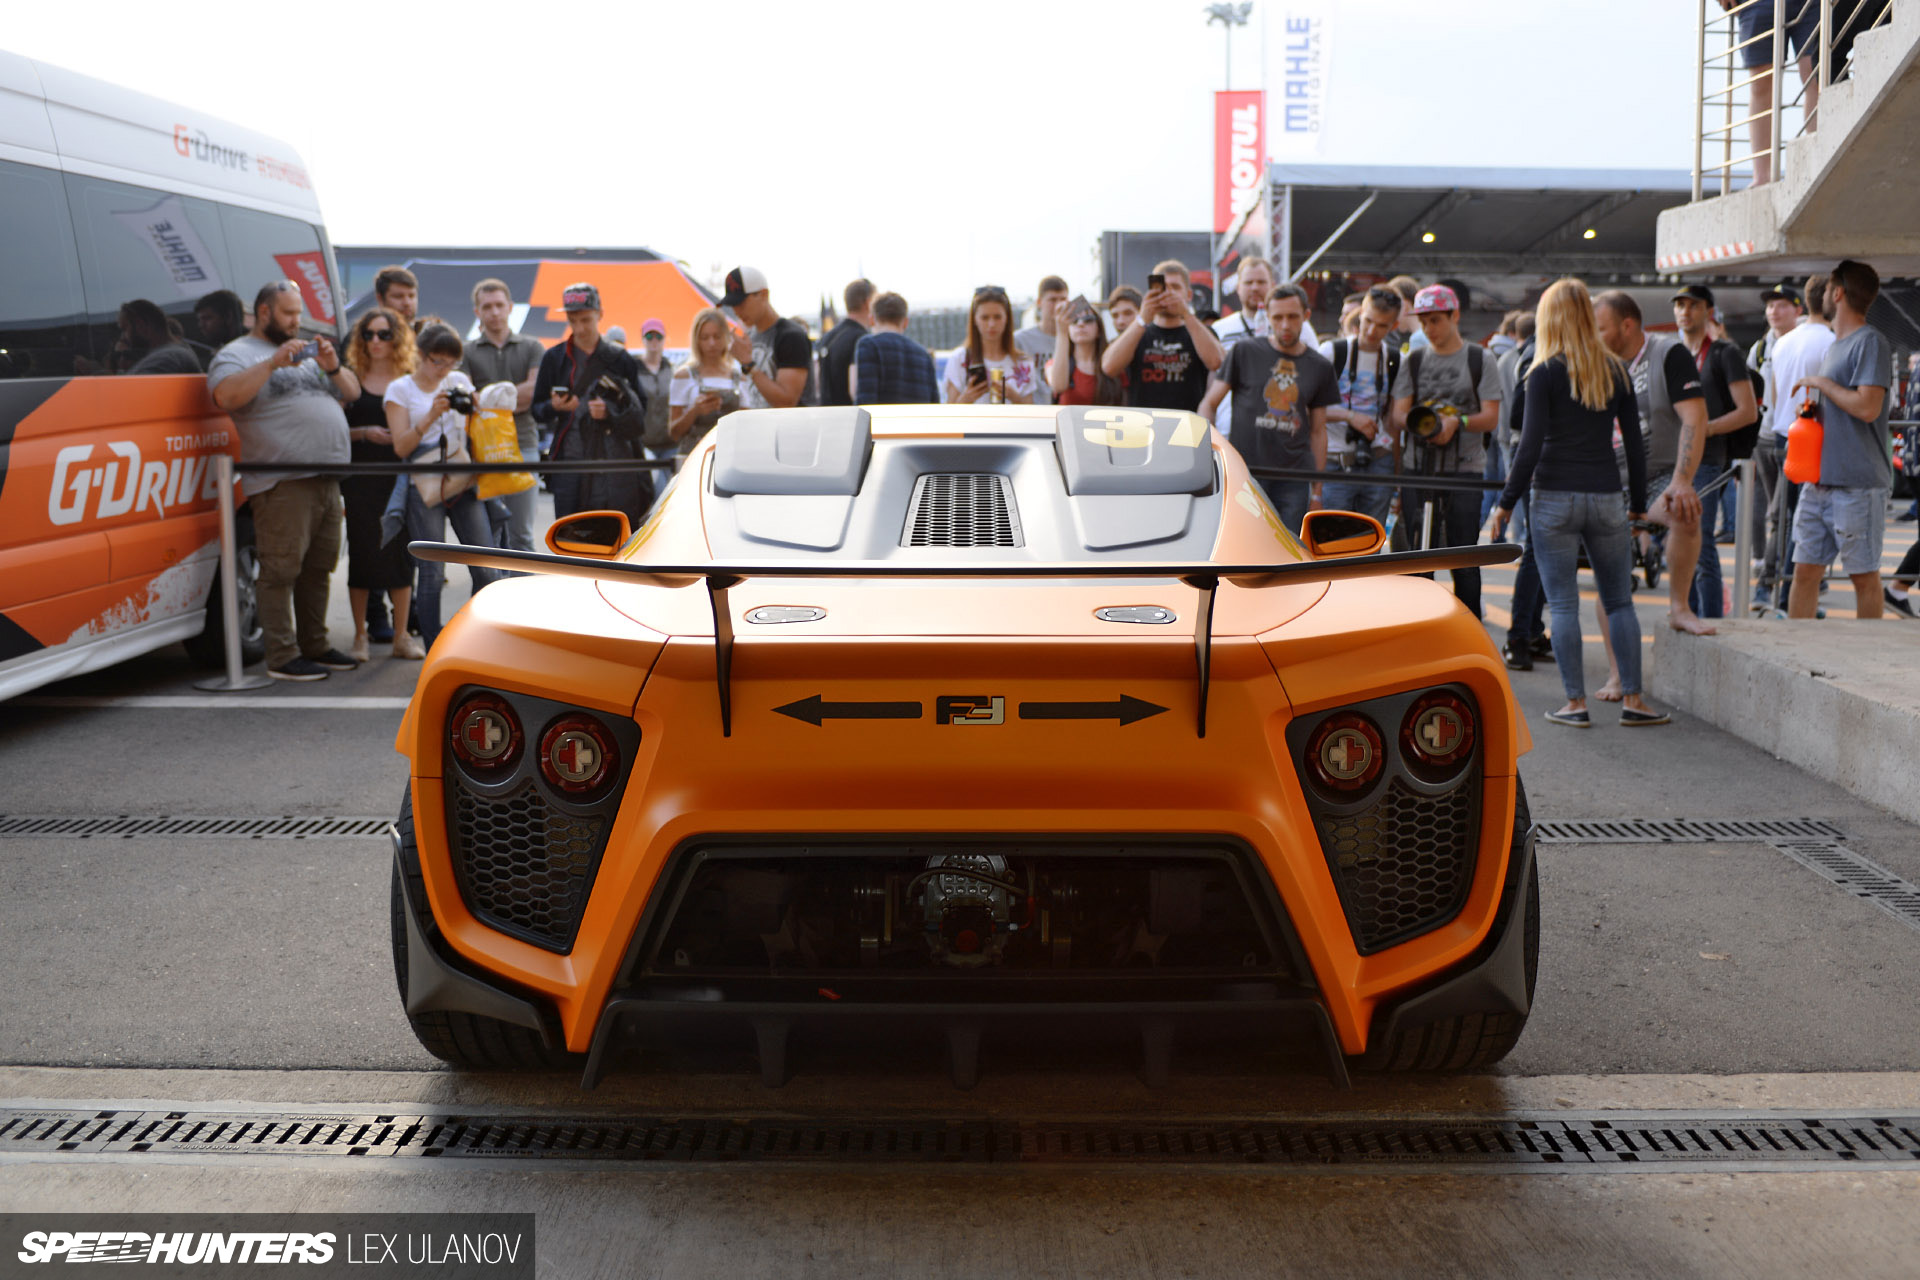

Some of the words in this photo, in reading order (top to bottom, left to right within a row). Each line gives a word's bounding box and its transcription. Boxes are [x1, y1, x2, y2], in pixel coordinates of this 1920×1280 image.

[1285, 18, 1309, 132] MAHLE
[1143, 369, 1165, 382] DO
[165, 431, 229, 452] ТОПЛИВО
[1083, 409, 1208, 449] 37
